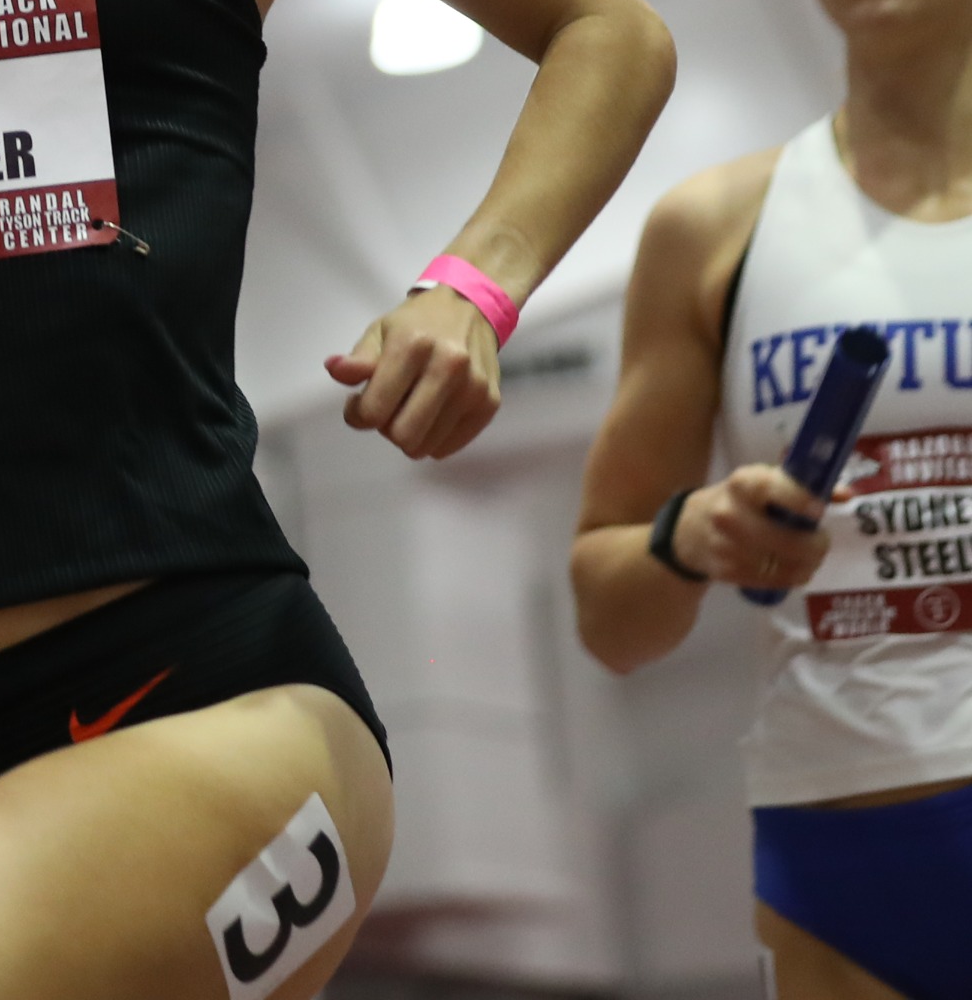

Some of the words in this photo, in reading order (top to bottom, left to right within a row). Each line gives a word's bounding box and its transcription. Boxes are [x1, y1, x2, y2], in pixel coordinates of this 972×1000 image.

[3, 223, 88, 250] CENTER
[44, 206, 90, 227] TRACK
[752, 318, 972, 414] KETU
[223, 830, 340, 985] 3
